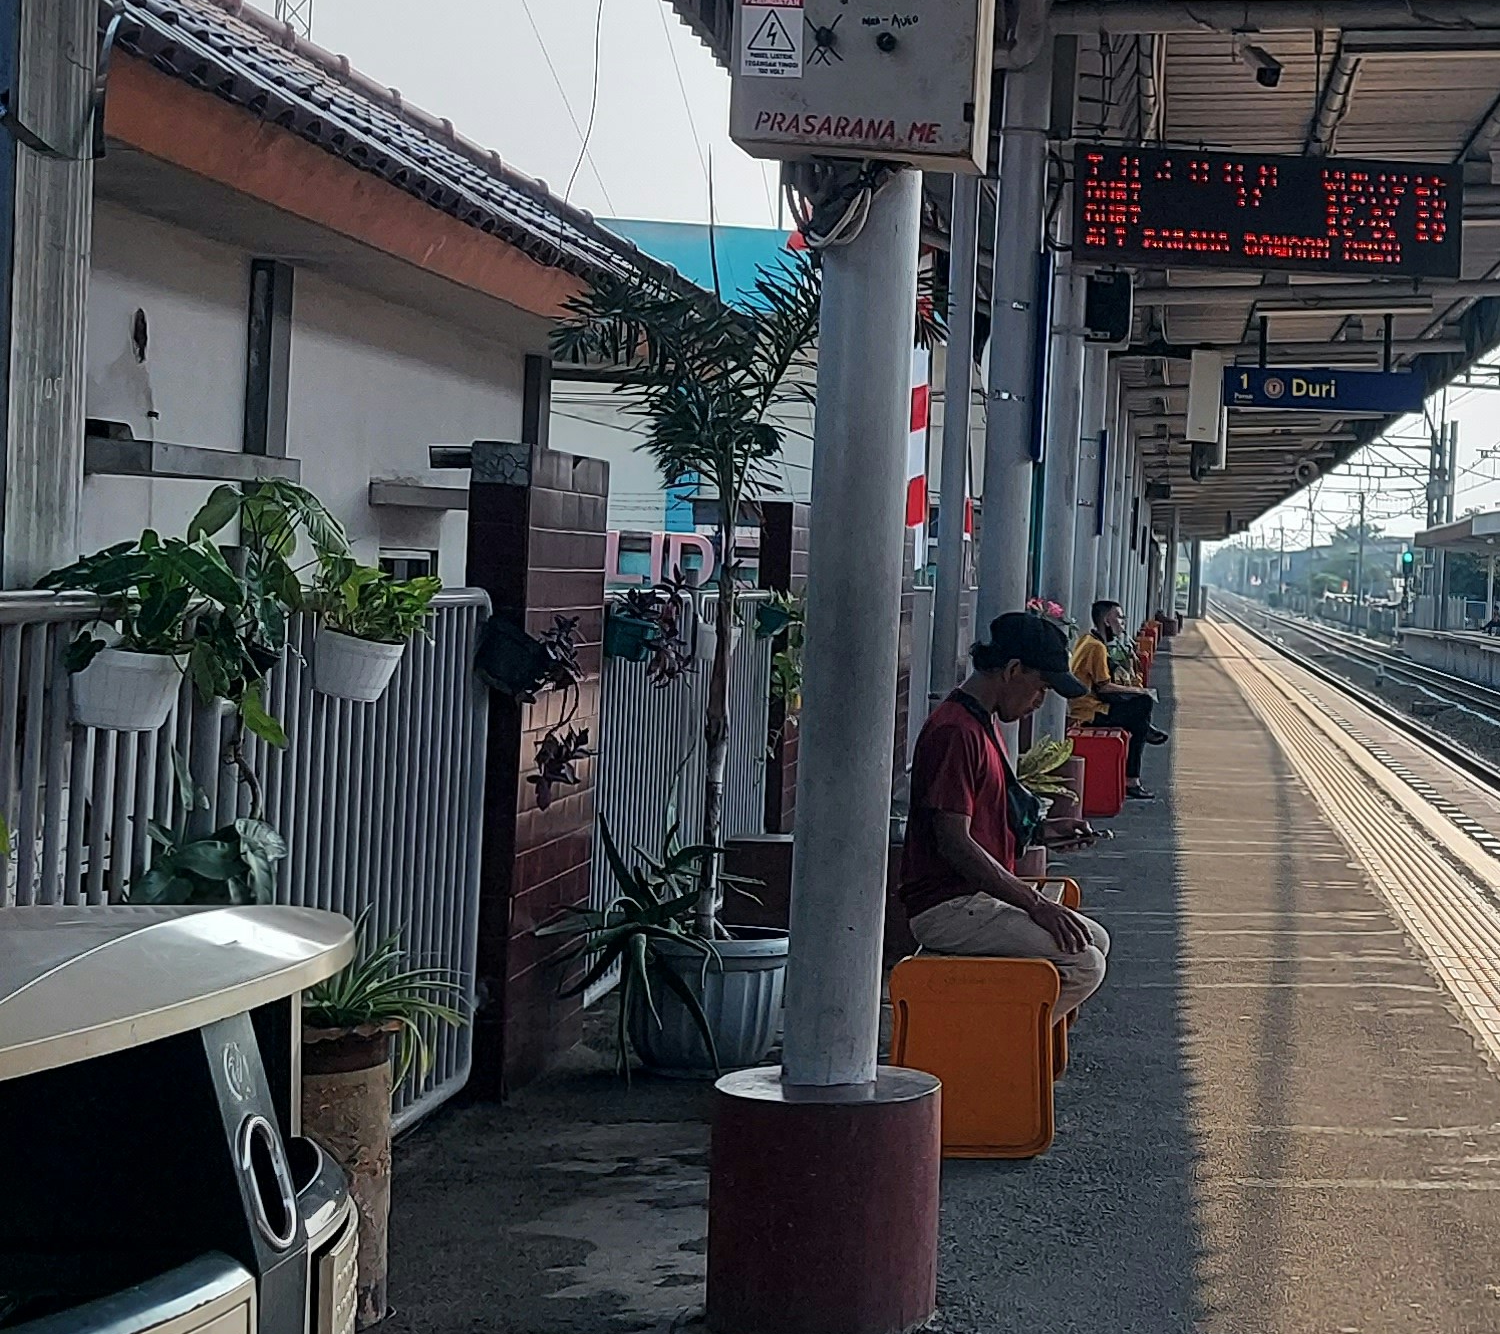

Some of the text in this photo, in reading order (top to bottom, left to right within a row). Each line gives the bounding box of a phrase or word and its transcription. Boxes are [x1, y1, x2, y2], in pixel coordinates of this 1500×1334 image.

[755, 111, 895, 139] PRASARANA
[1240, 372, 1248, 390] 1
[1292, 378, 1336, 398] Duri
